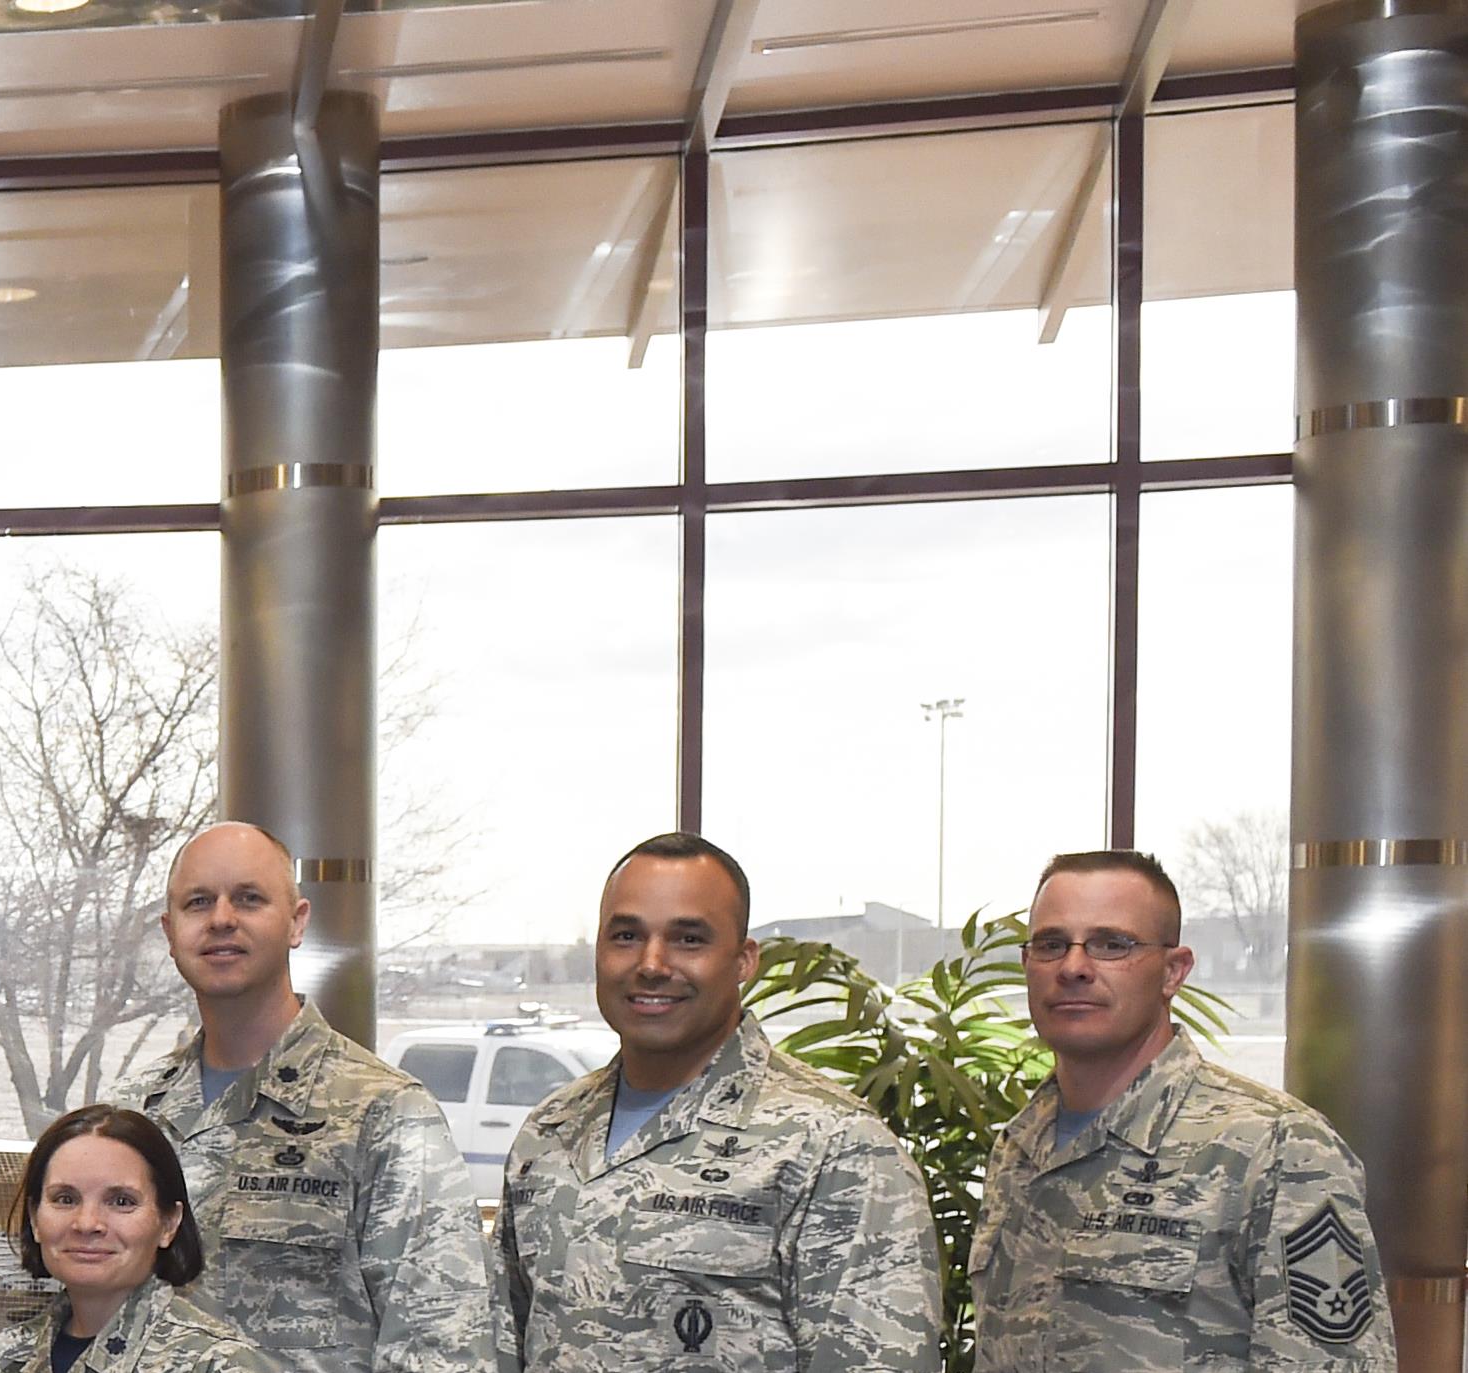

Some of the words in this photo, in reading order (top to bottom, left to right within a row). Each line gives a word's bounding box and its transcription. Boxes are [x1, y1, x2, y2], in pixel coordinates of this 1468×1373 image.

[238, 1176, 262, 1192] U.S.
[266, 1177, 289, 1192] AIR
[292, 1178, 340, 1198] FORCE
[678, 1195, 706, 1215] AIR
[708, 1200, 762, 1223] FORCE
[1113, 1214, 1136, 1232] AIR
[1138, 1216, 1189, 1239] FORCE
